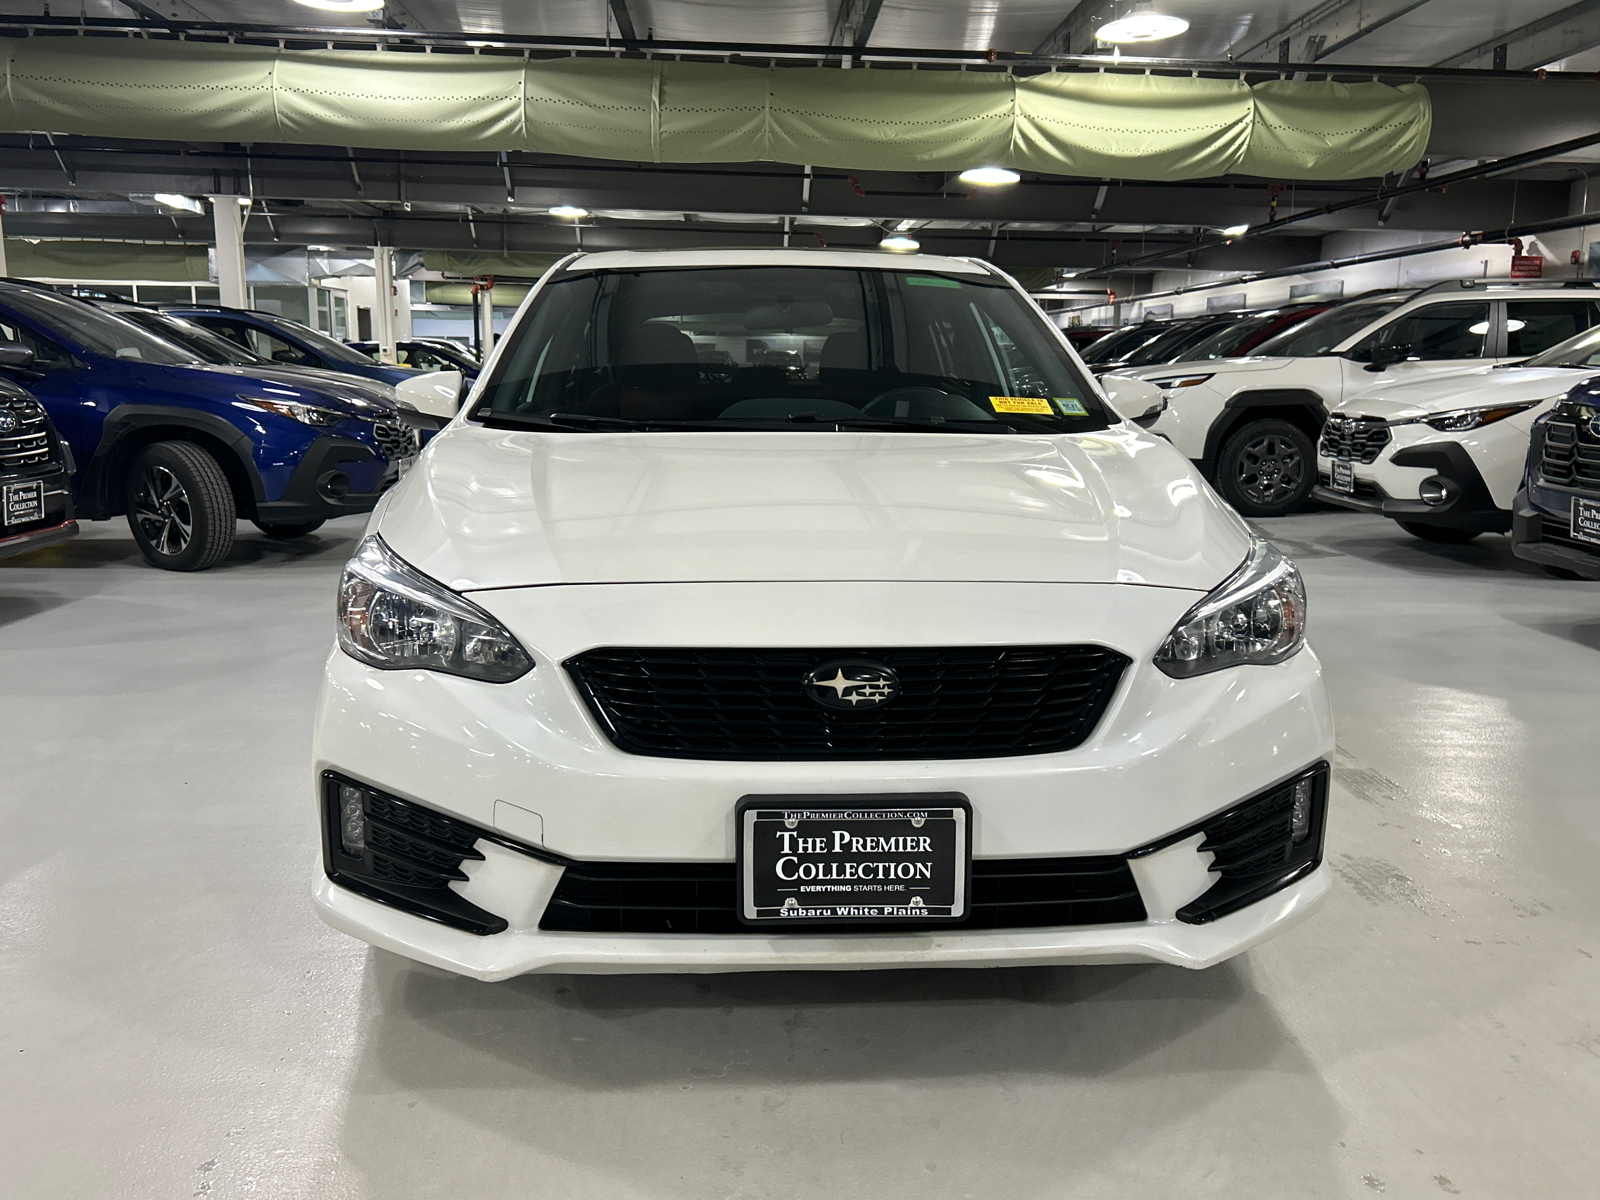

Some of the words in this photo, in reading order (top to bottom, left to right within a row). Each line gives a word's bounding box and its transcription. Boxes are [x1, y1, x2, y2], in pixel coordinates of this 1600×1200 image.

[9, 493, 19, 502] THE
[19, 491, 37, 500] PREMIER
[9, 500, 38, 511] COLLECTION
[1578, 506, 1591, 518] THE
[776, 830, 828, 854] THE
[831, 830, 933, 853] PREMIER
[775, 856, 933, 881] COLLECTION
[853, 884, 882, 892] STARTS
[883, 884, 907, 892] HERE.
[780, 907, 831, 917] Subaru
[836, 907, 878, 916] White
[884, 906, 929, 916] Plains
